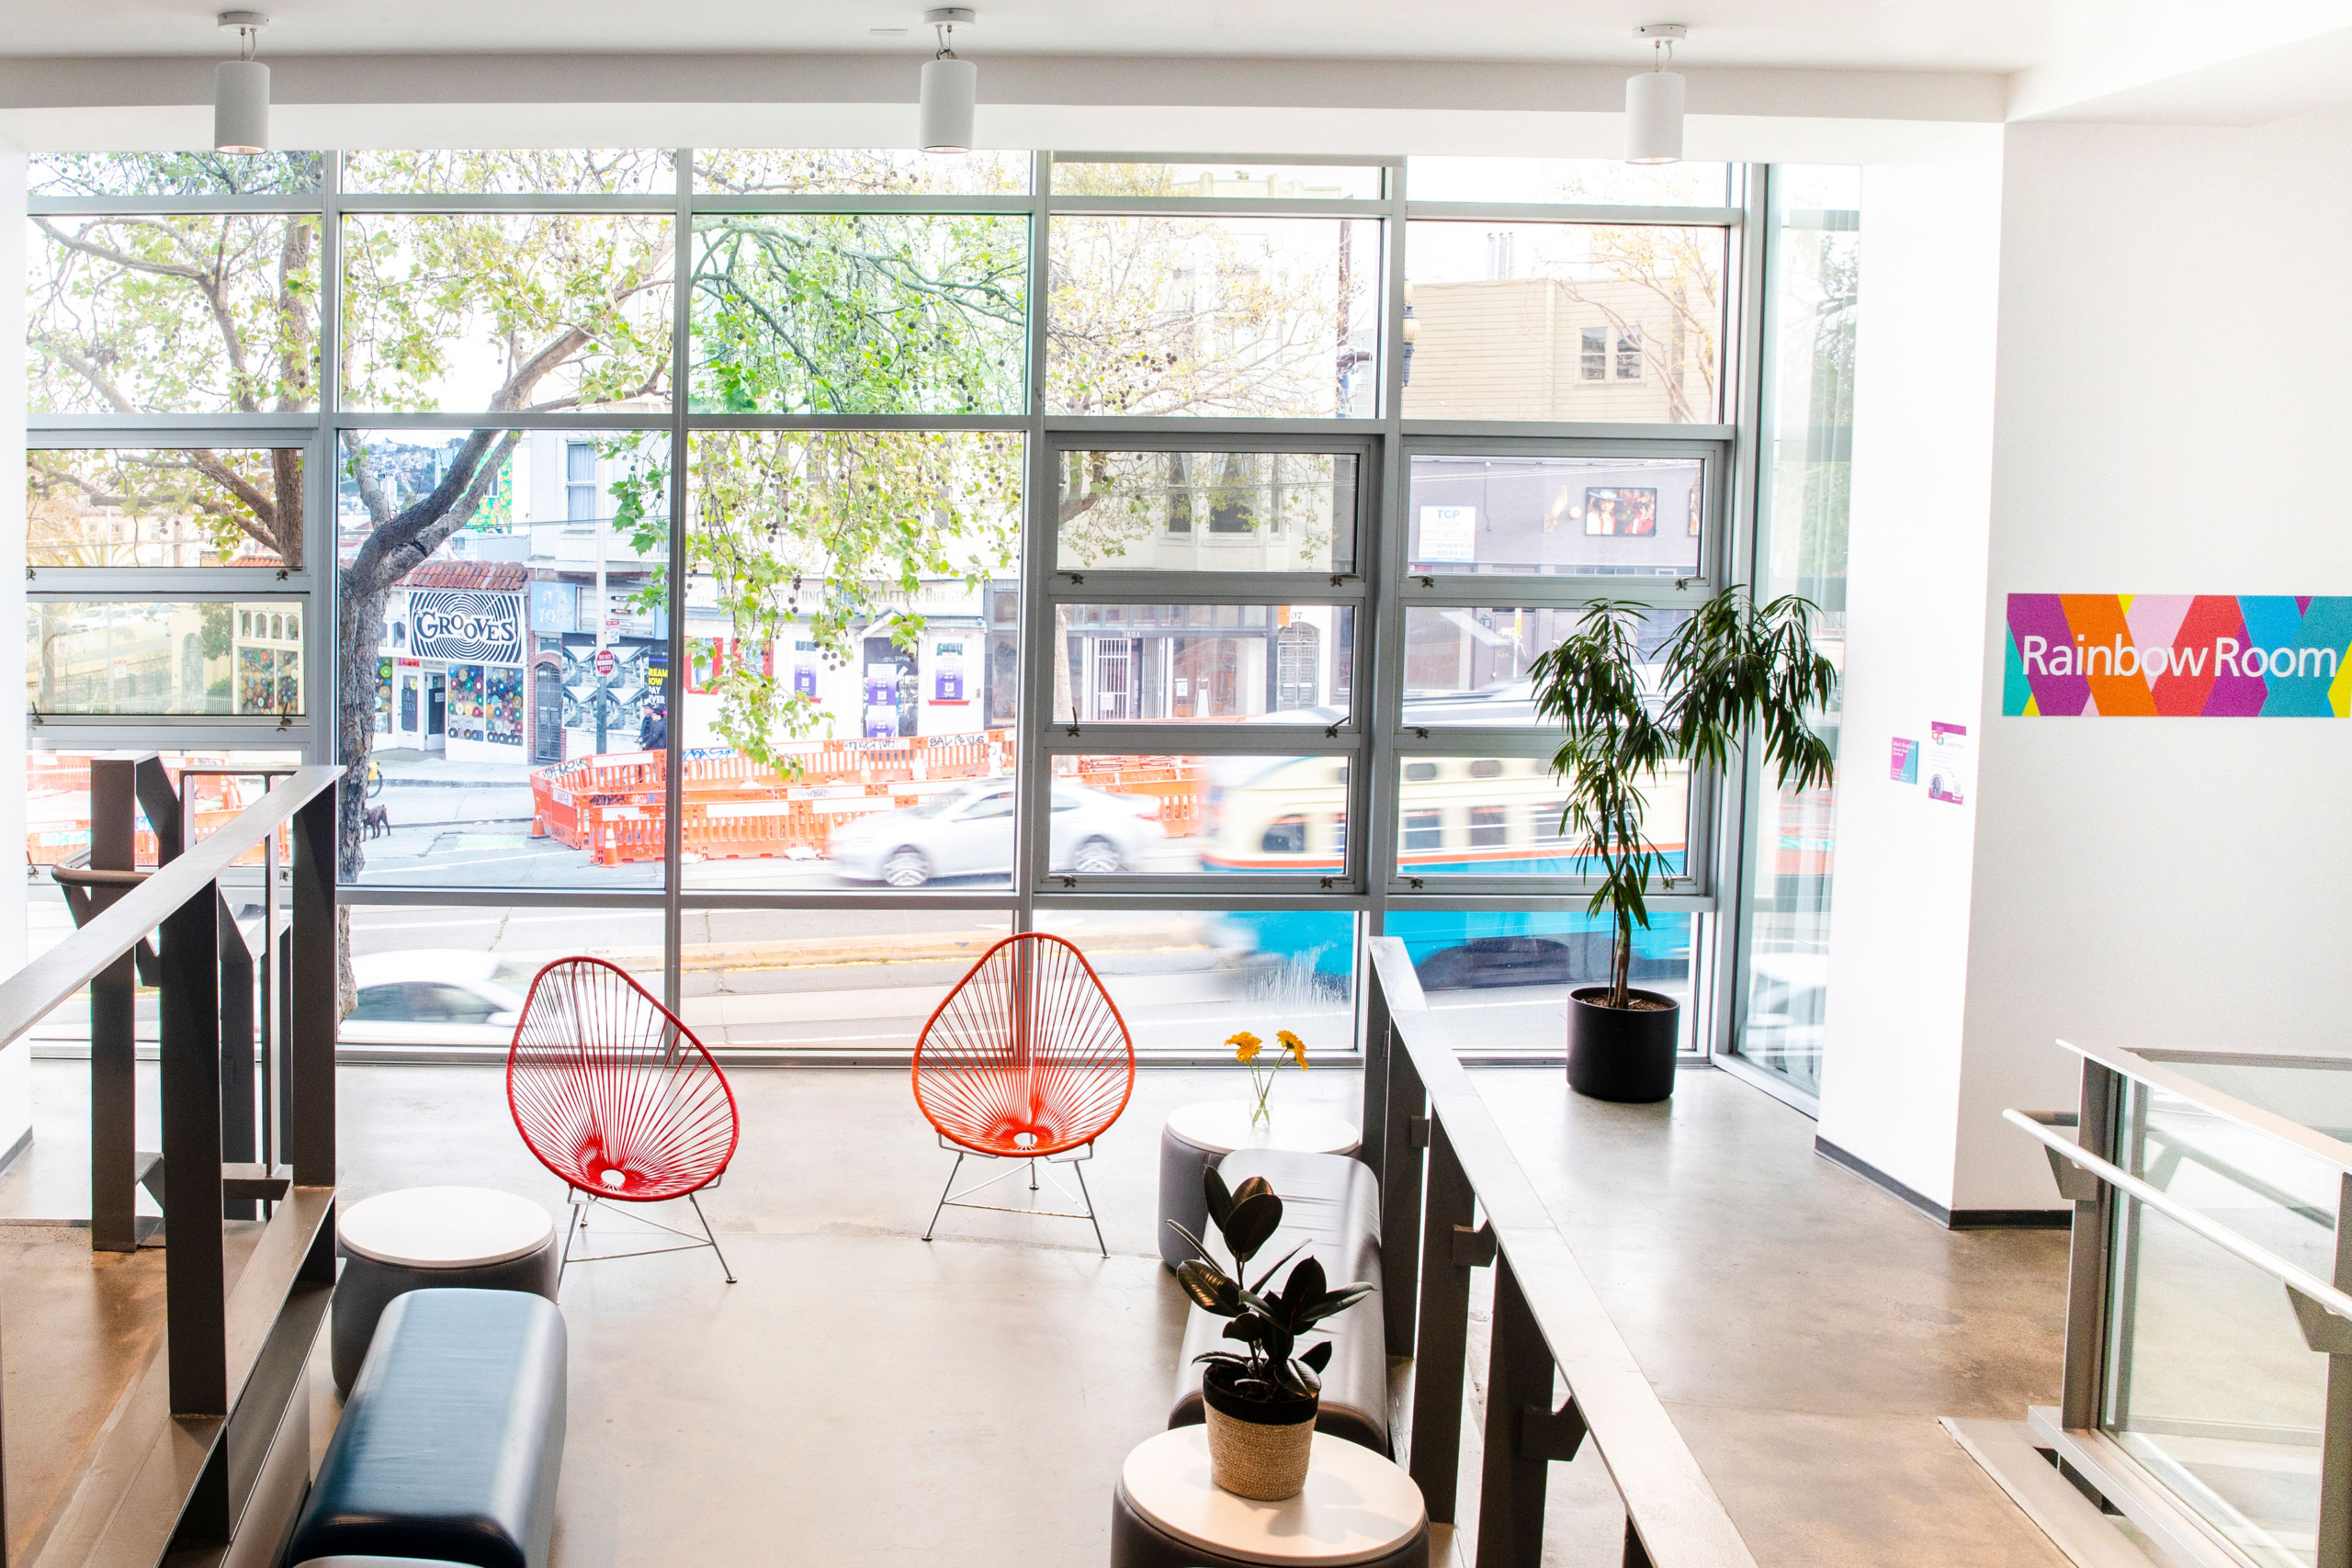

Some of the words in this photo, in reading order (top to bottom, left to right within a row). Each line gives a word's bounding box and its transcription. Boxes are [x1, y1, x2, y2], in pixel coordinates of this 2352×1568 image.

[1437, 509, 1461, 519] TCP
[1291, 612, 1303, 620] 07
[416, 611, 514, 642] GROOVES
[2022, 634, 2208, 677] Rainbow
[2214, 637, 2337, 678] Room
[649, 668, 668, 678] REAM
[649, 695, 665, 705] EVER
